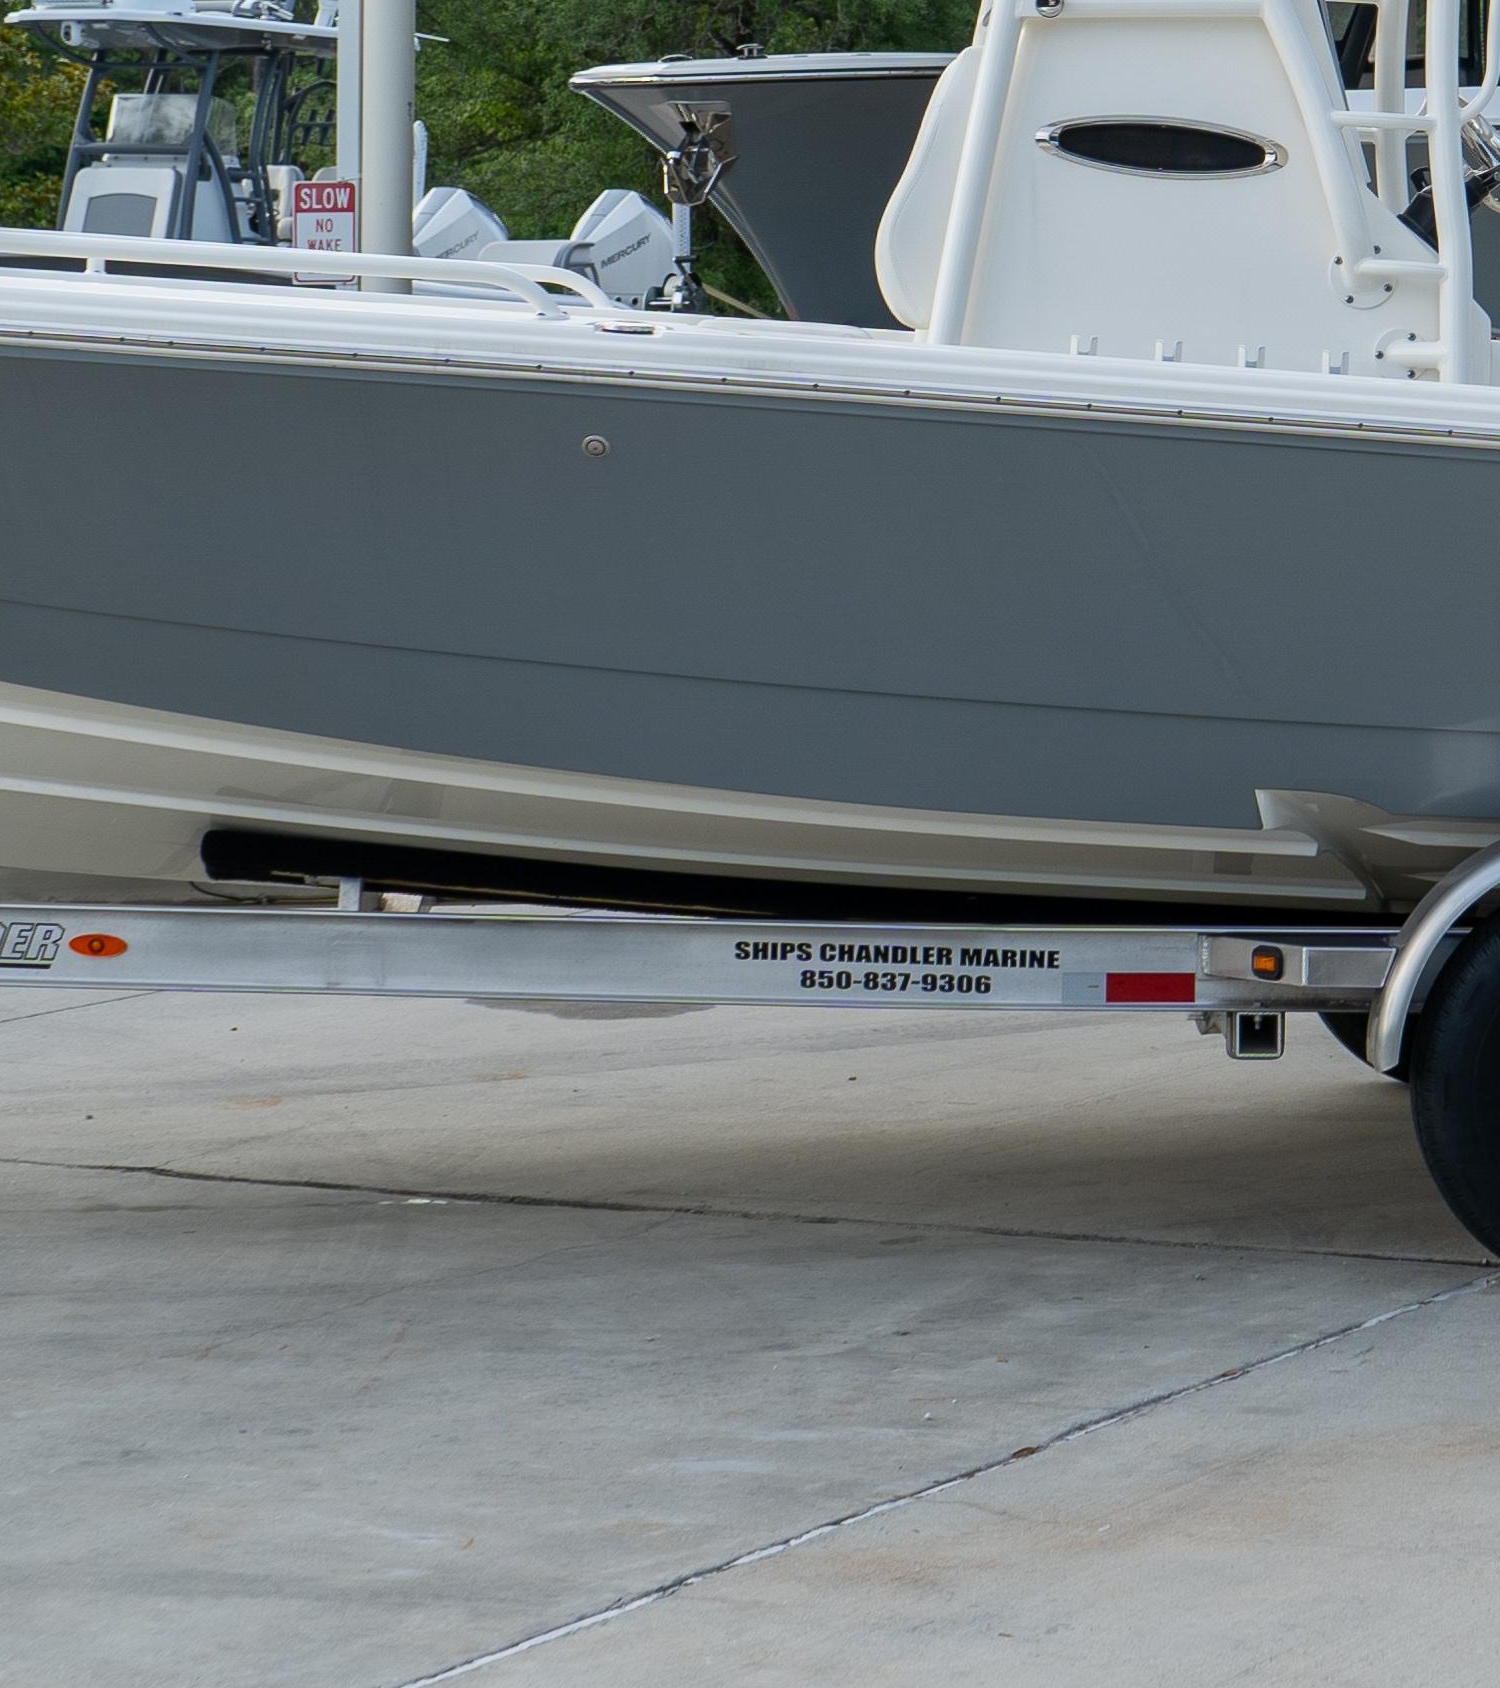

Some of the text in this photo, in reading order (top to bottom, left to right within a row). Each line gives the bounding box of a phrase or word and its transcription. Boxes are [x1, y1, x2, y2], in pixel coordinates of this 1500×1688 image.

[300, 187, 350, 209] SLOW
[316, 218, 334, 232] NO
[435, 231, 479, 259] ERCURY
[601, 232, 651, 269] MERCURY
[734, 940, 1061, 970] SHIPS CHANDLER MARINE
[799, 969, 993, 995] 850-837-9306
